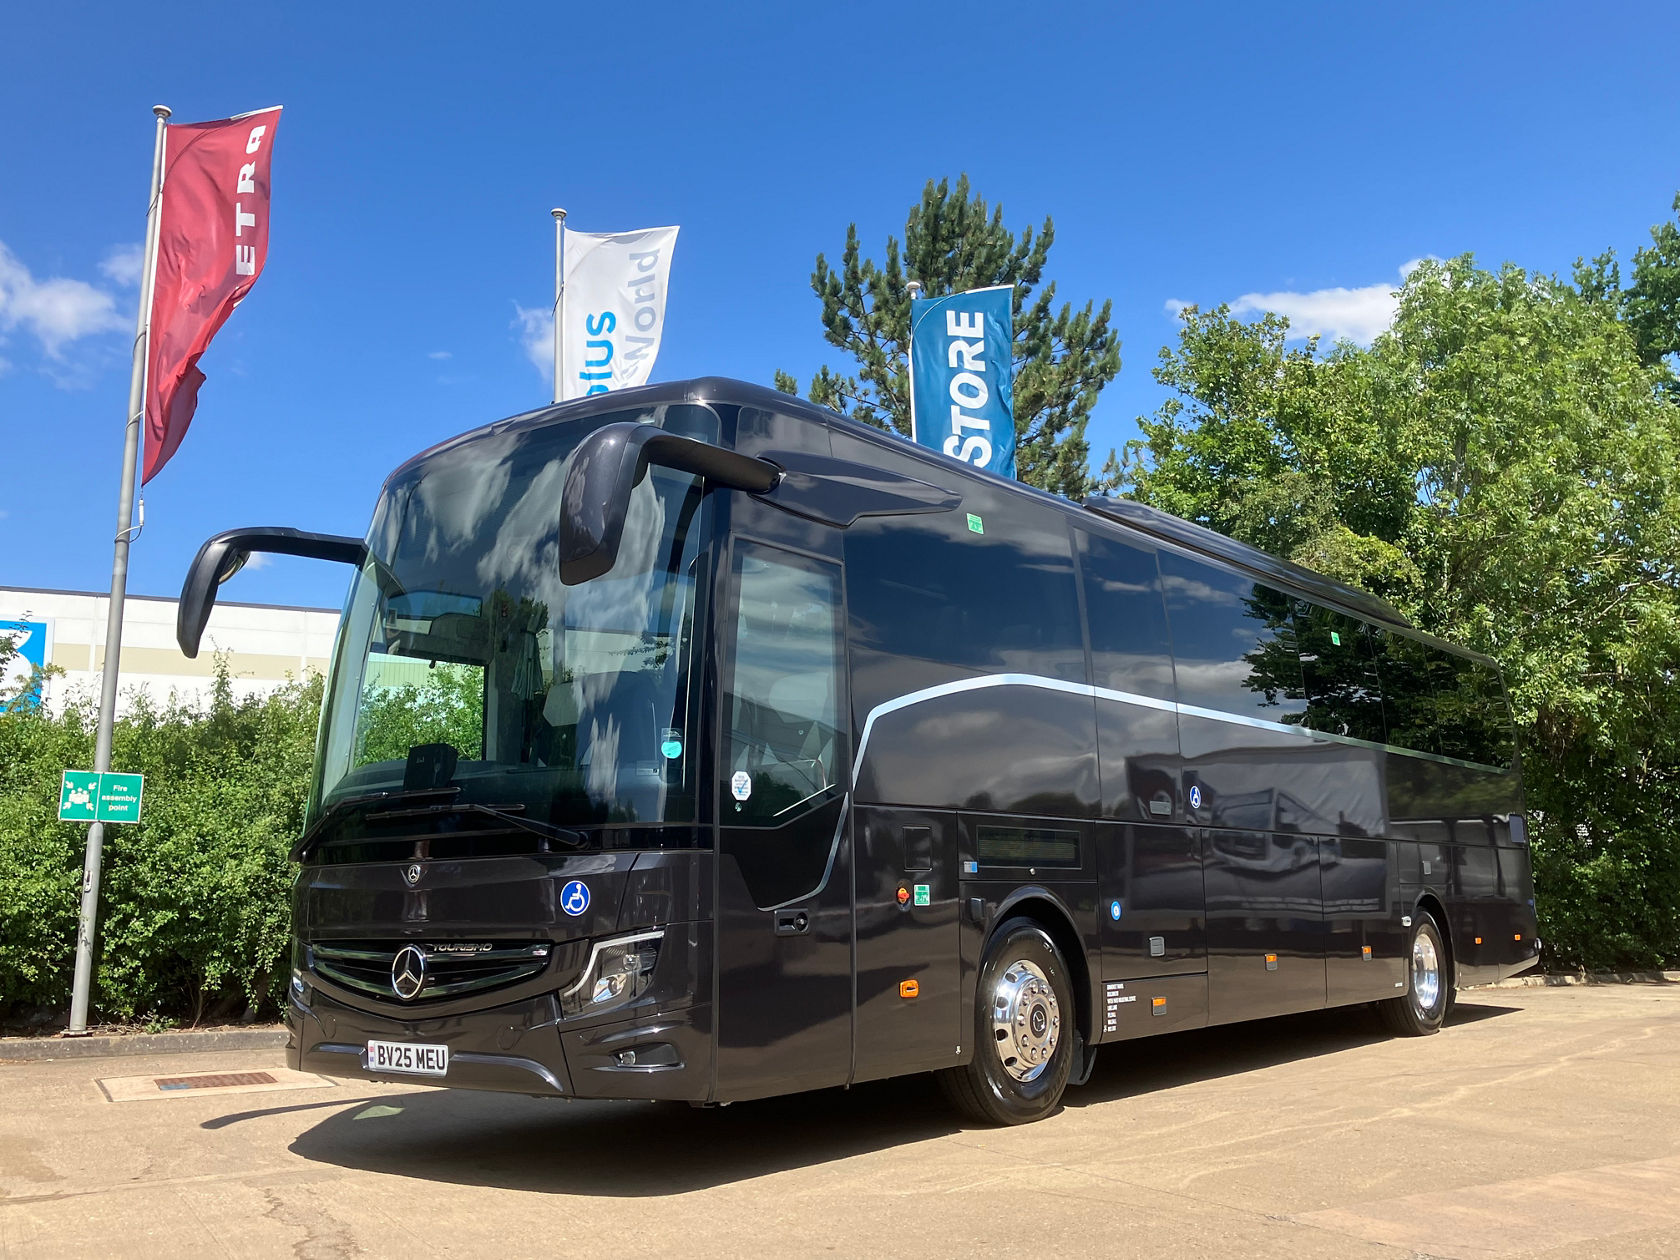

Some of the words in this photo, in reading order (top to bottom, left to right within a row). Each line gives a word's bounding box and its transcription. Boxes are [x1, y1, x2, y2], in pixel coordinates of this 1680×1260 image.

[233, 125, 267, 307] ETRA
[943, 310, 993, 468] STORE
[101, 795, 137, 803] assembly
[428, 943, 493, 951] TOURISMO
[377, 1045, 412, 1068] BV25
[416, 1048, 446, 1070] MEU
